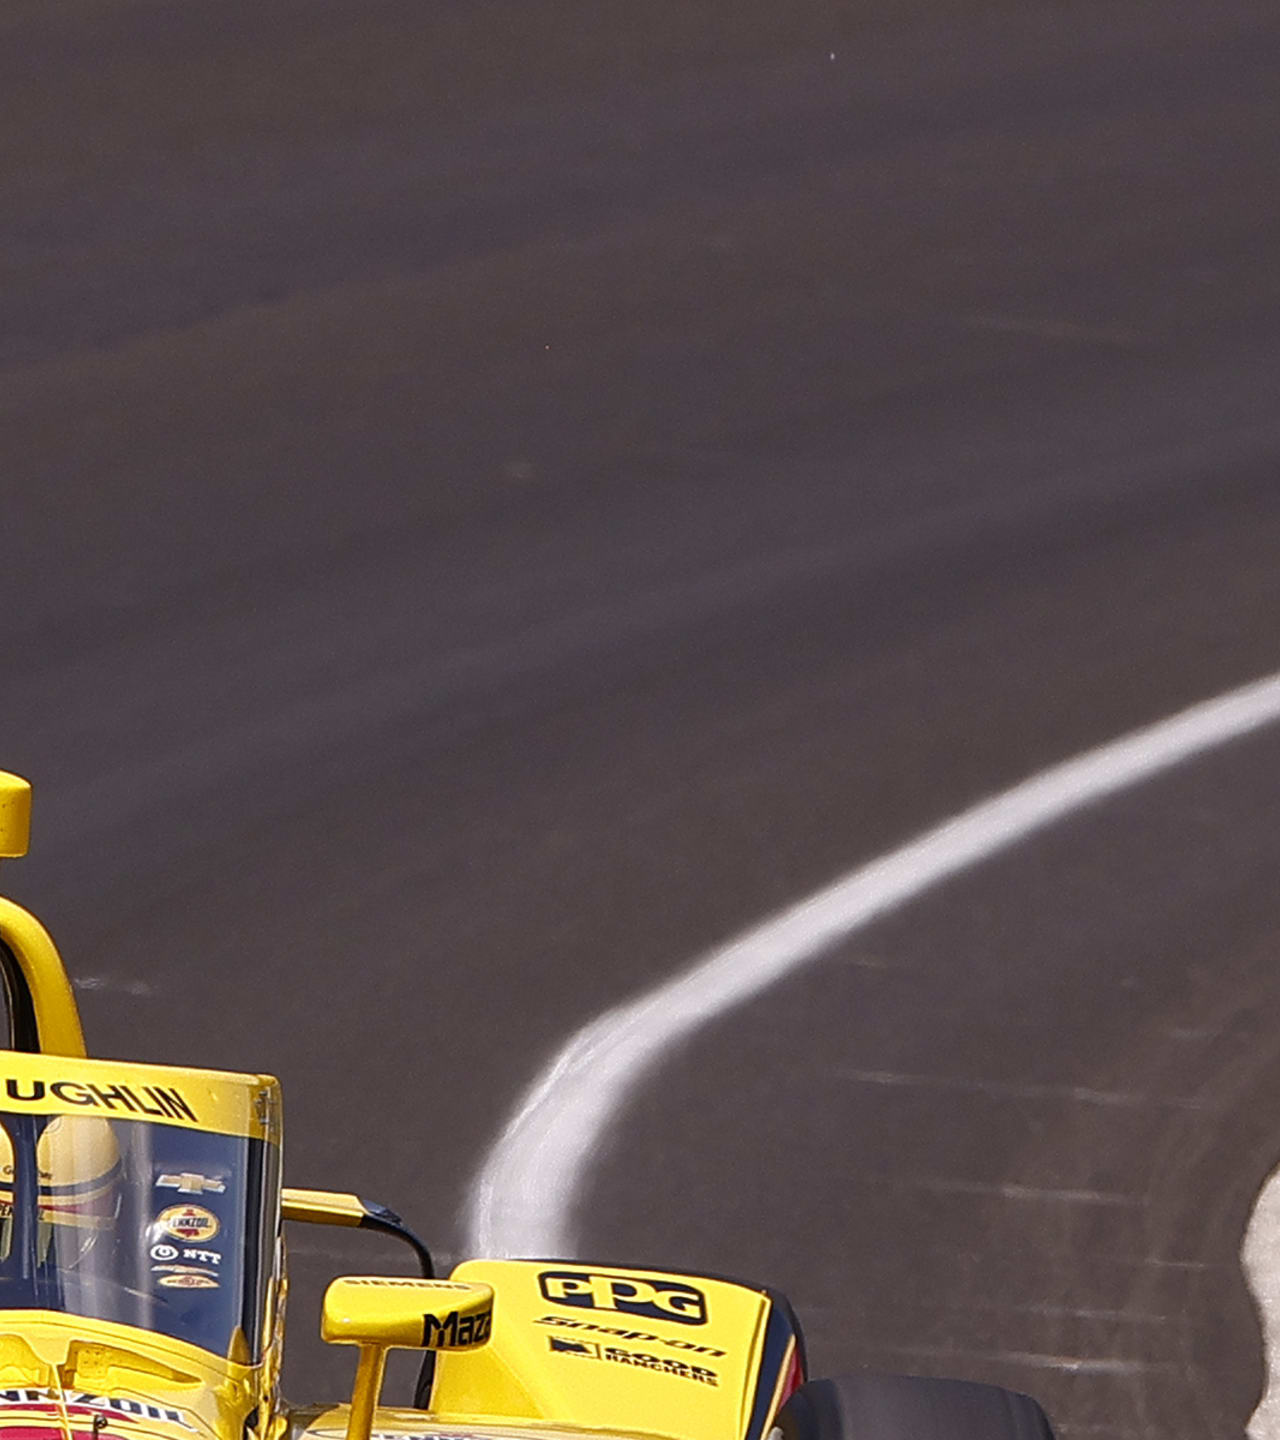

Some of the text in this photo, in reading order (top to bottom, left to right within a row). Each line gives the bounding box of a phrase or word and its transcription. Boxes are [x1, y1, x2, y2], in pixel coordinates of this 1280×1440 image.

[183, 1248, 222, 1265] NTT
[343, 1279, 471, 1290] SIEMENS
[544, 1275, 703, 1319] PPG
[421, 1311, 491, 1347] Maz
[533, 1316, 727, 1358] Snap-on
[605, 1347, 717, 1377] GOOD
[605, 1354, 720, 1387] RANCHERS
